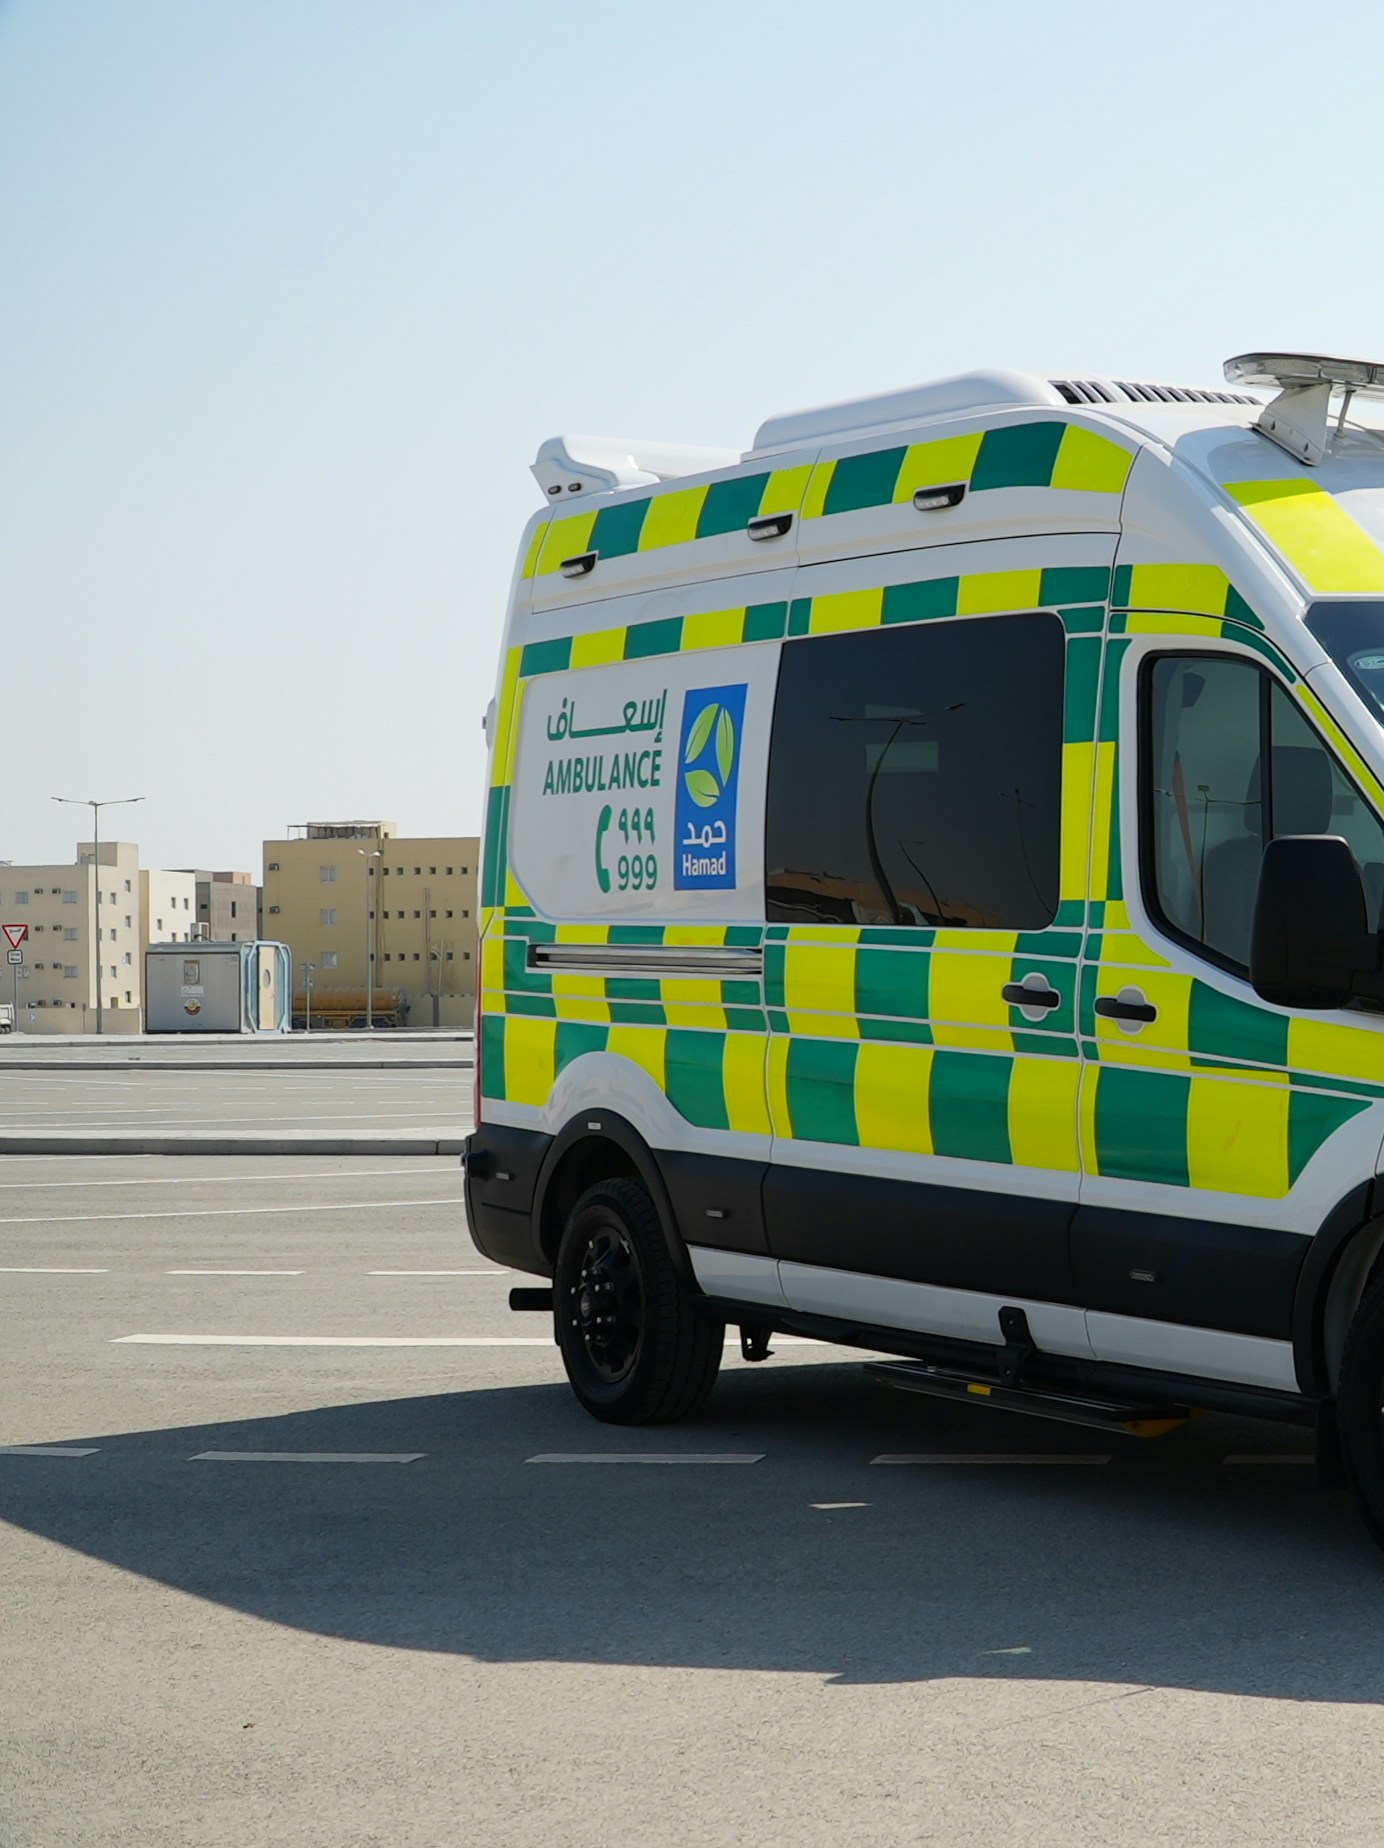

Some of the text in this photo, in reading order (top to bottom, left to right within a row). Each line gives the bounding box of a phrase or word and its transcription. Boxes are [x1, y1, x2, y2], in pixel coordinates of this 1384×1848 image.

[542, 750, 663, 796] AMBULANCE
[618, 806, 656, 846] ٩٩٩
[682, 820, 726, 848] حمد
[617, 854, 658, 891] 999
[682, 851, 727, 876] Hamad
